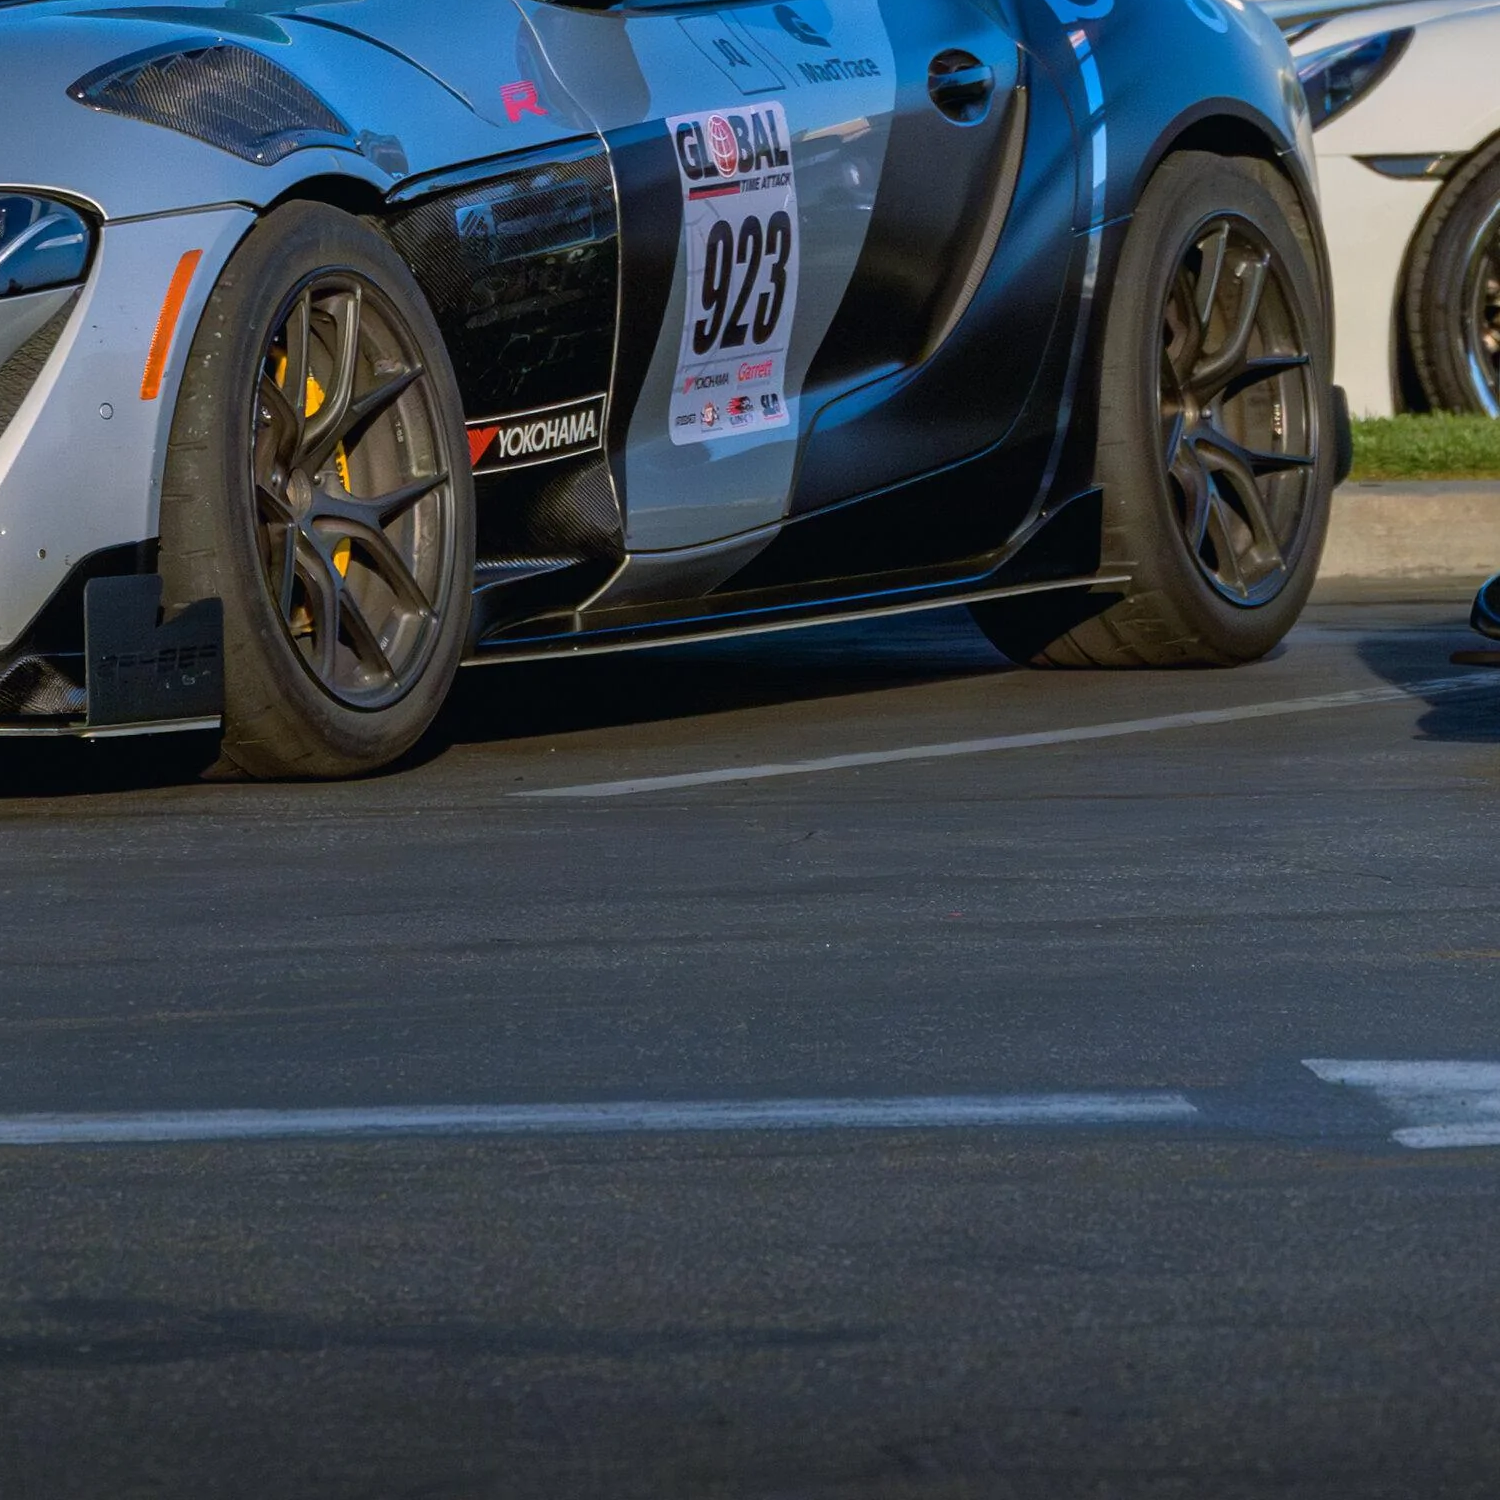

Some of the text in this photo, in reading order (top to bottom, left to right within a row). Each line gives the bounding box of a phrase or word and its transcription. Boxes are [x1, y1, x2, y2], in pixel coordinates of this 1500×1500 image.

[796, 58, 881, 84] MadTrace
[676, 110, 789, 180] GLOBAL
[740, 172, 791, 194] TIME ATTACK
[693, 211, 791, 355] 923
[737, 360, 773, 382] Garrett
[498, 410, 596, 458] YOKOHAMA
